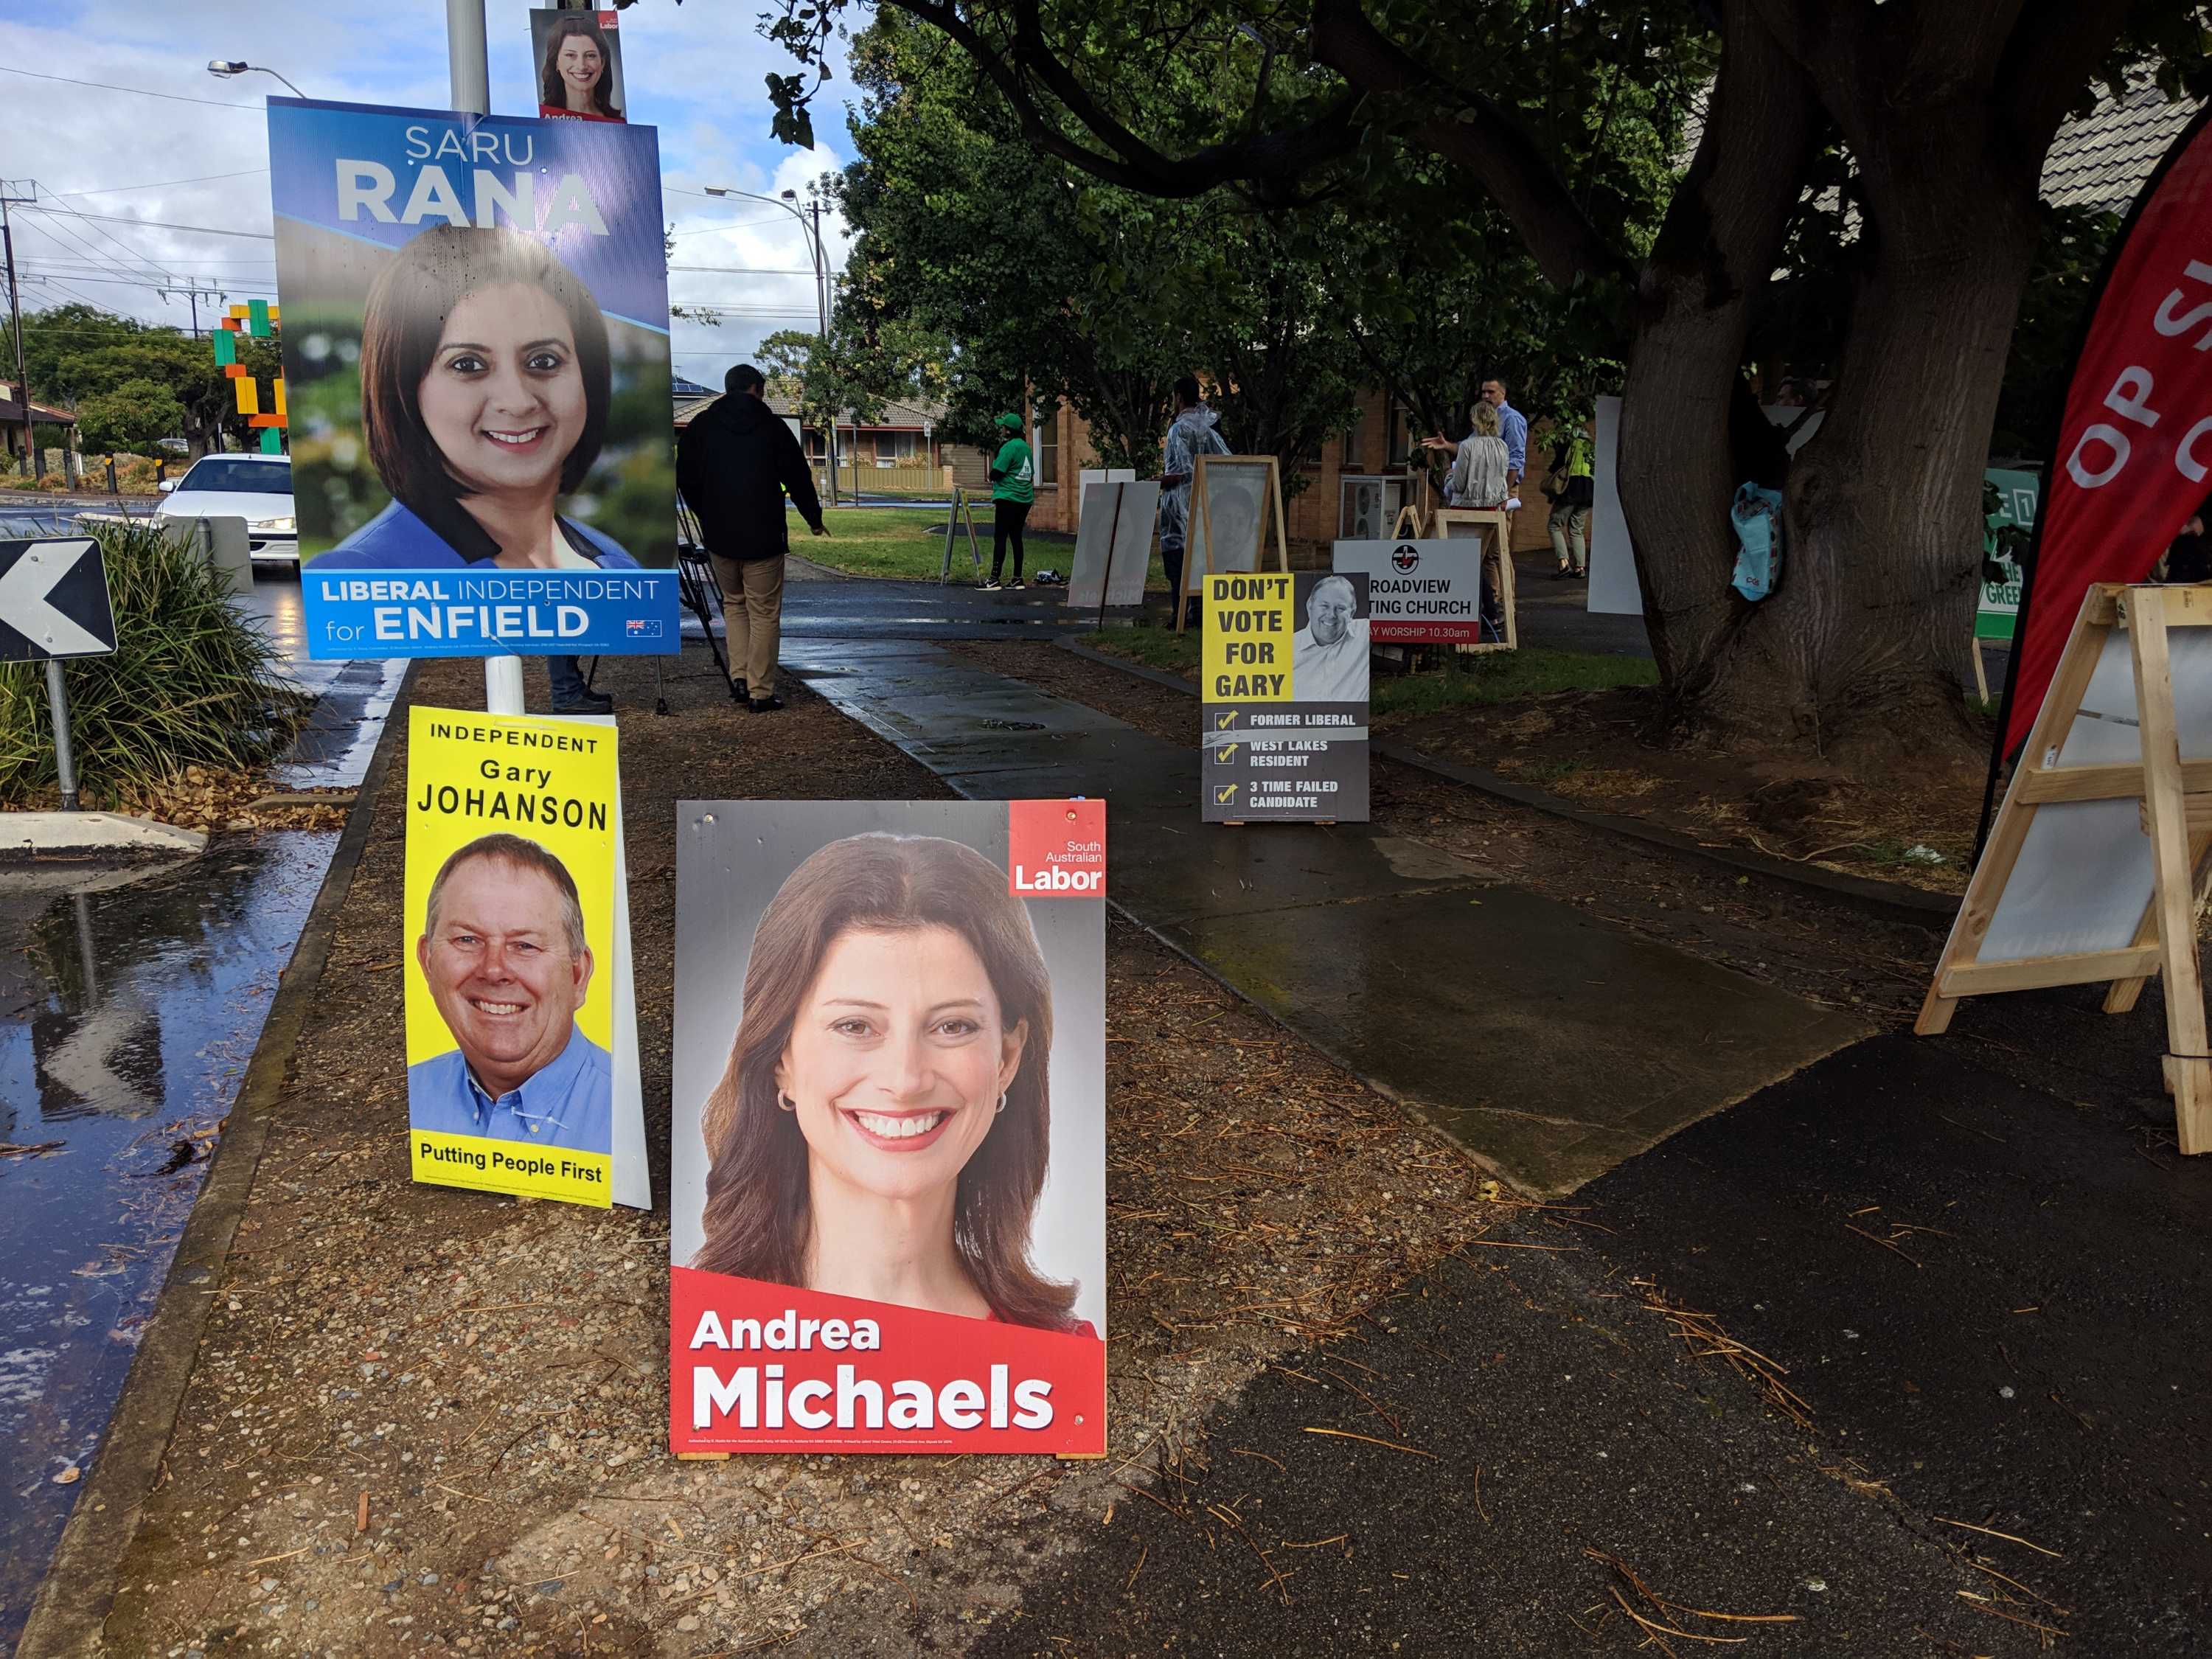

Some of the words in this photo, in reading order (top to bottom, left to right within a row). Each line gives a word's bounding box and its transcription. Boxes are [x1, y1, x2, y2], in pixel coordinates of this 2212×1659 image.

[406, 126, 533, 166] SARU
[335, 159, 611, 237] RANA
[2065, 366, 2161, 488] OP
[2001, 562, 2021, 582] HE
[321, 580, 450, 602] LIBERAL
[459, 580, 659, 600] INDEPENDENT
[1214, 578, 1289, 601] DON'T
[1370, 580, 1451, 594] ROADVIEW
[1986, 584, 2021, 605] GREE
[1368, 600, 1401, 613] TING
[1406, 600, 1471, 614] CHURCH
[326, 620, 365, 641] for
[374, 605, 589, 640] ENFIELD
[1218, 611, 1282, 633] VOTE
[1381, 627, 1426, 637] WORSHIP
[1428, 627, 1470, 637] 10.30am
[1225, 642, 1274, 664] FOR
[1215, 674, 1285, 697] GARY
[1250, 714, 1301, 726] FORMER
[1305, 714, 1356, 726] LIBERAL
[431, 723, 598, 754] INDEPENDENT
[1250, 741, 1284, 751] WEST
[1288, 740, 1328, 751] LAKES
[1250, 755, 1309, 767] RESIDENT
[480, 759, 552, 789] Gary
[1250, 781, 1258, 792] 3
[1262, 781, 1291, 792] TIME
[1295, 781, 1338, 792] FAILED
[417, 784, 606, 831] JOHANSON
[1250, 796, 1318, 807] CANDIDATE
[1046, 852, 1102, 863] Australian
[1067, 841, 1101, 852] South
[1015, 866, 1102, 890] Labor
[421, 1143, 486, 1169] Putting
[493, 1152, 554, 1176] People
[561, 1161, 602, 1183] First
[689, 1310, 880, 1350] Andrea
[693, 1363, 1054, 1430] Michaels
